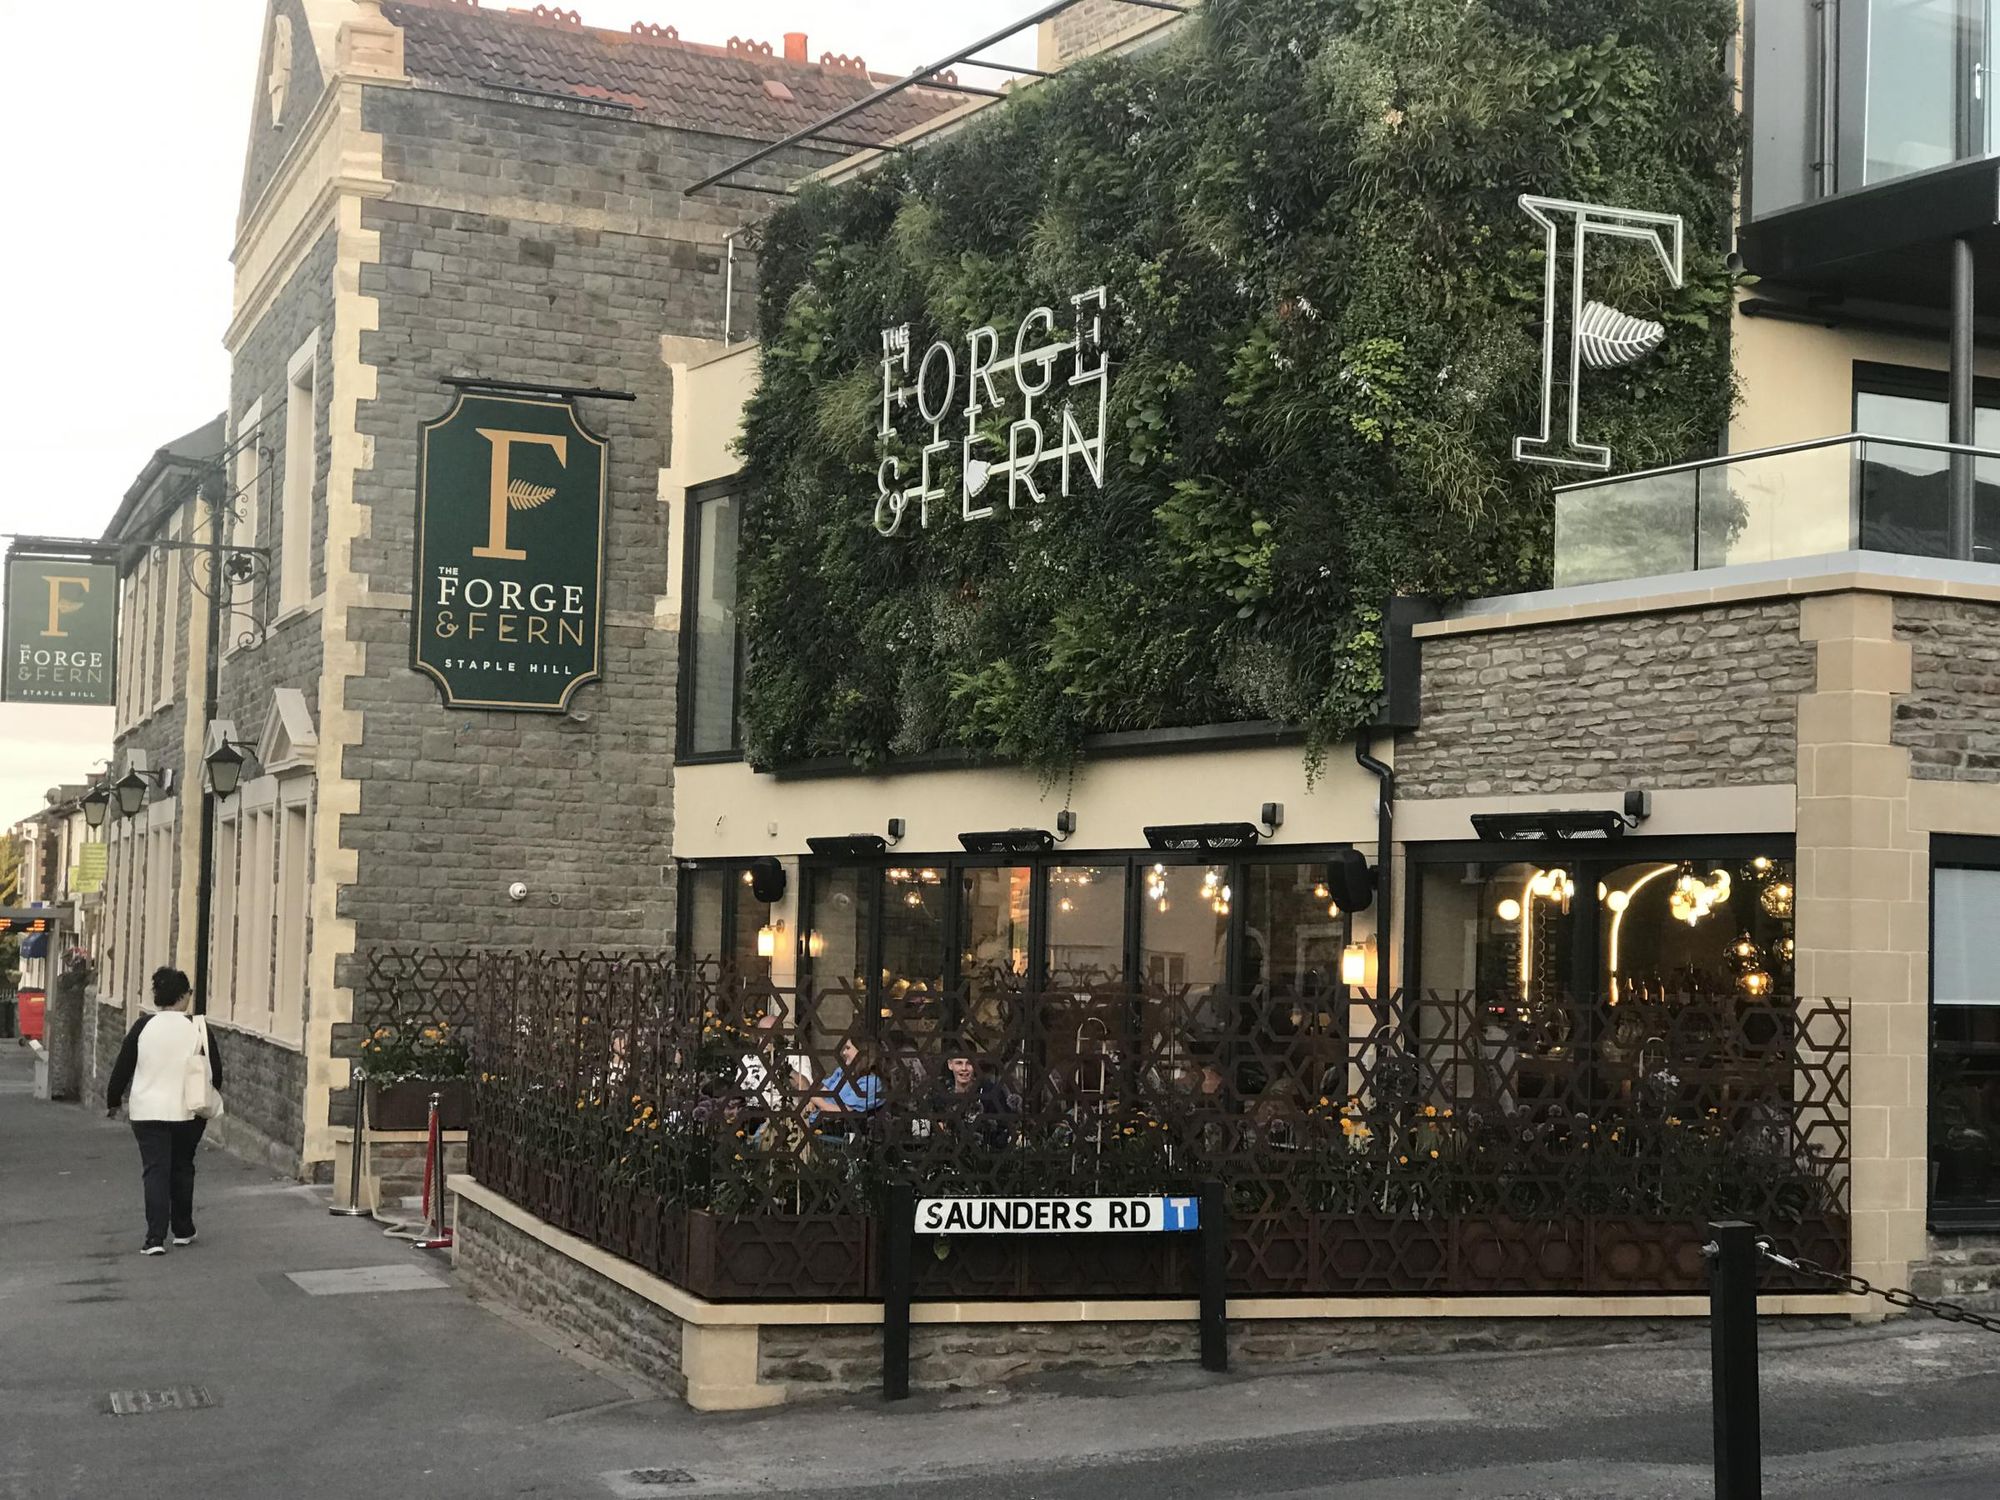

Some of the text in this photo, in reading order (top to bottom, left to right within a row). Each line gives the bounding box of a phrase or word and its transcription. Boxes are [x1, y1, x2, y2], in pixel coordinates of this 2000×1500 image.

[880, 321, 910, 350] THE
[878, 285, 1106, 437] FORGE
[438, 566, 459, 576] THE
[437, 576, 583, 614] FORGE
[468, 612, 584, 646] FERN
[19, 649, 102, 668] FORGE
[445, 658, 572, 675] STAPLE HILL
[23, 689, 63, 697] STAPLE
[925, 1201, 1151, 1230] SAUNDERS RD
